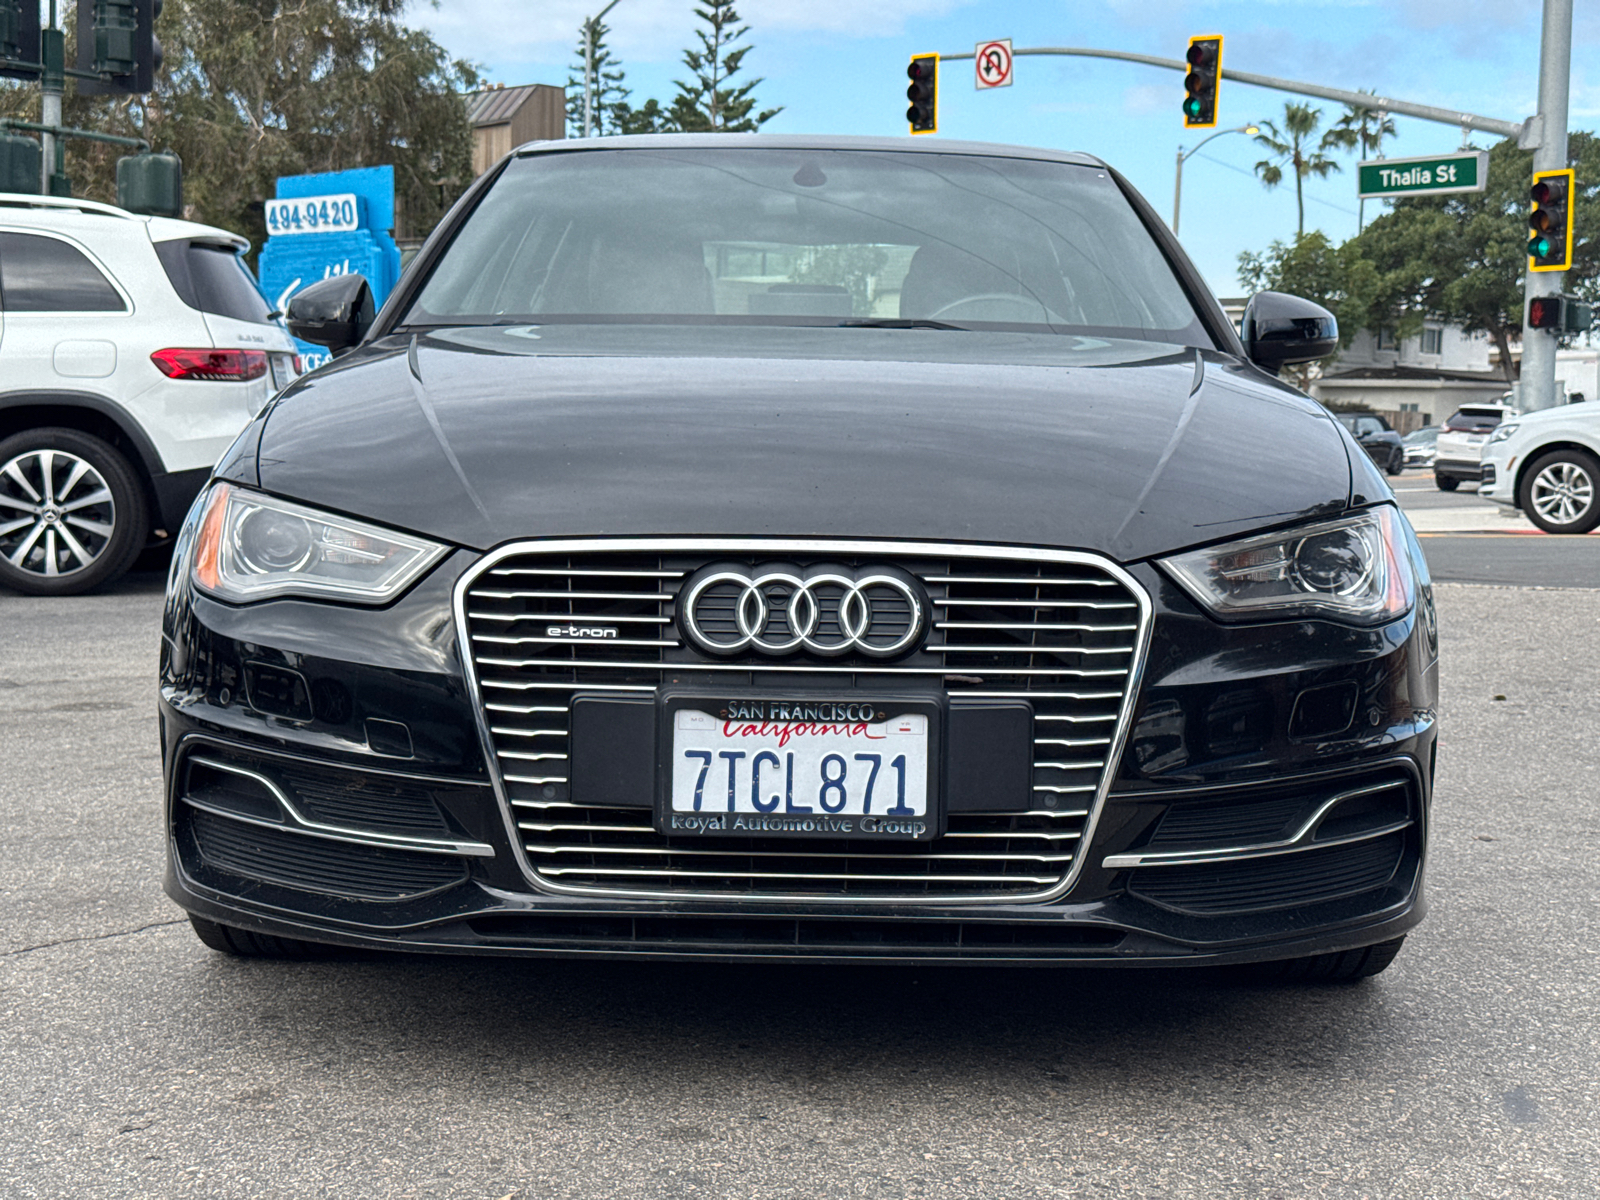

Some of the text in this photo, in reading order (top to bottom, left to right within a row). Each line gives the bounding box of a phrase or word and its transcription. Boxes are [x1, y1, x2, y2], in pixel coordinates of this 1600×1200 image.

[1379, 164, 1457, 187] Thalia St
[547, 626, 617, 638] e-tron
[728, 700, 874, 721] SAN FRANCISCO
[723, 720, 887, 748] California
[684, 749, 915, 815] 7TCL871
[671, 813, 927, 839] Royal Automotive Group
